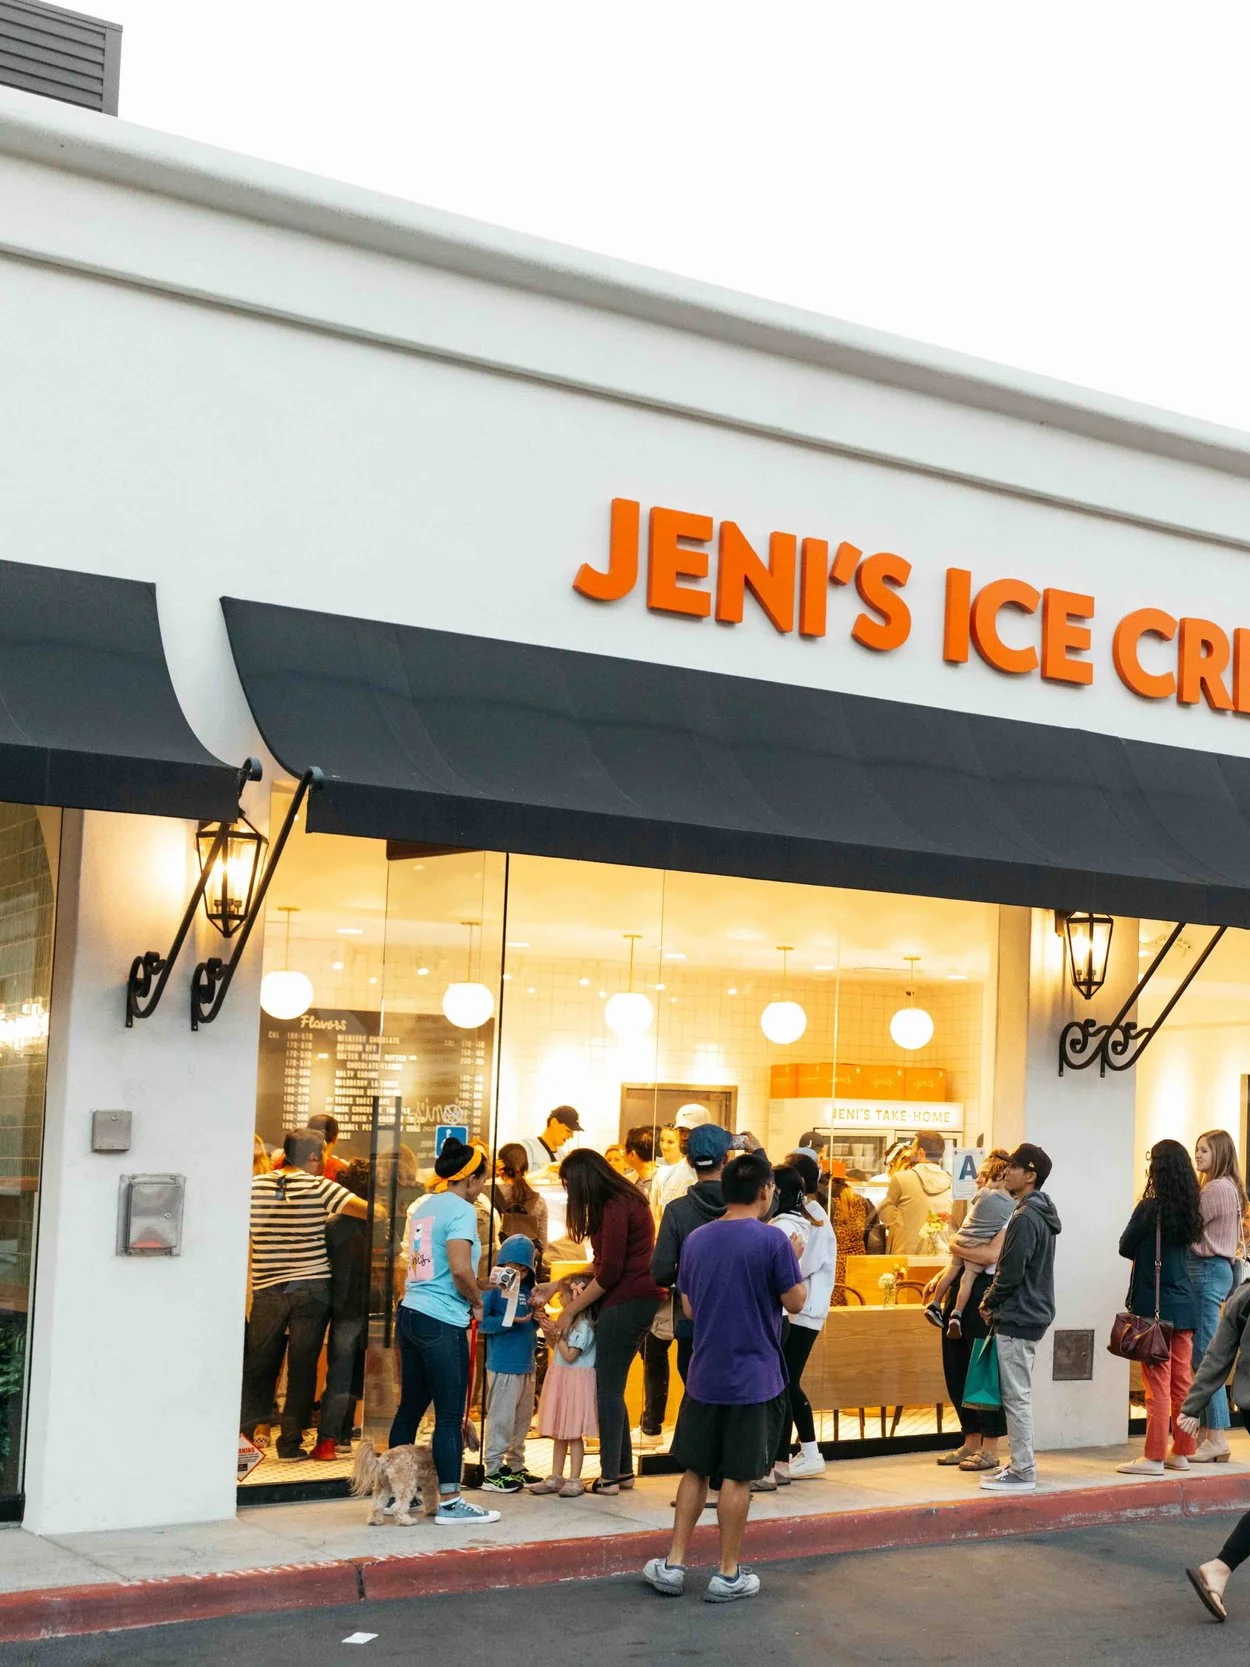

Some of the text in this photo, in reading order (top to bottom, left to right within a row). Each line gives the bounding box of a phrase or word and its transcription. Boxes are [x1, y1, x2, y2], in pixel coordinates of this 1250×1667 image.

[572, 497, 912, 652] JENI'S
[943, 567, 1096, 686] ICE
[300, 1014, 348, 1031] Flavors
[875, 1109, 951, 1123] TAKE-HOME
[958, 1154, 978, 1181] A
